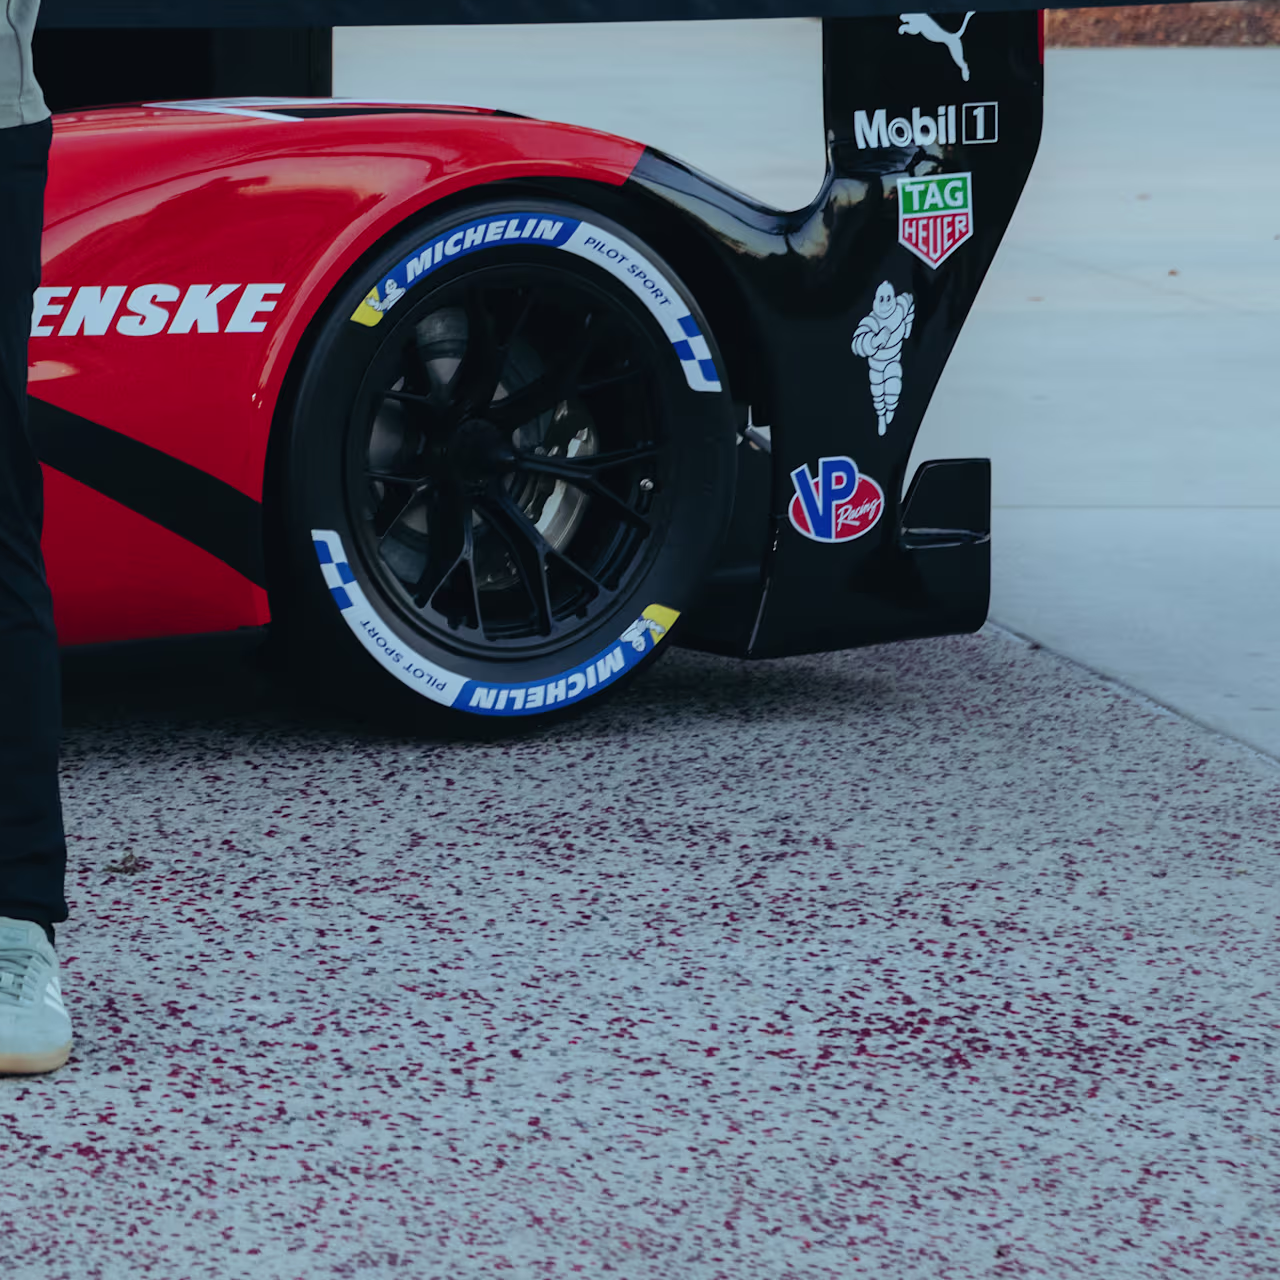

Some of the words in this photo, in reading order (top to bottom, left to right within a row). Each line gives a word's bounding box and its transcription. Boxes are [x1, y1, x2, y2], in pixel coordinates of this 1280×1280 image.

[853, 105, 956, 150] Mobil
[972, 106, 986, 141] 1
[904, 180, 964, 211] TAG
[405, 218, 564, 285] MICHELIN
[583, 236, 627, 266] PILOT
[626, 264, 672, 308] SPORT
[903, 214, 968, 262] HEUER
[790, 456, 860, 542] VP
[837, 497, 883, 532] Racing
[358, 620, 405, 665] SPORT
[403, 662, 448, 692] PILOT
[468, 646, 626, 711] MICHELIN
